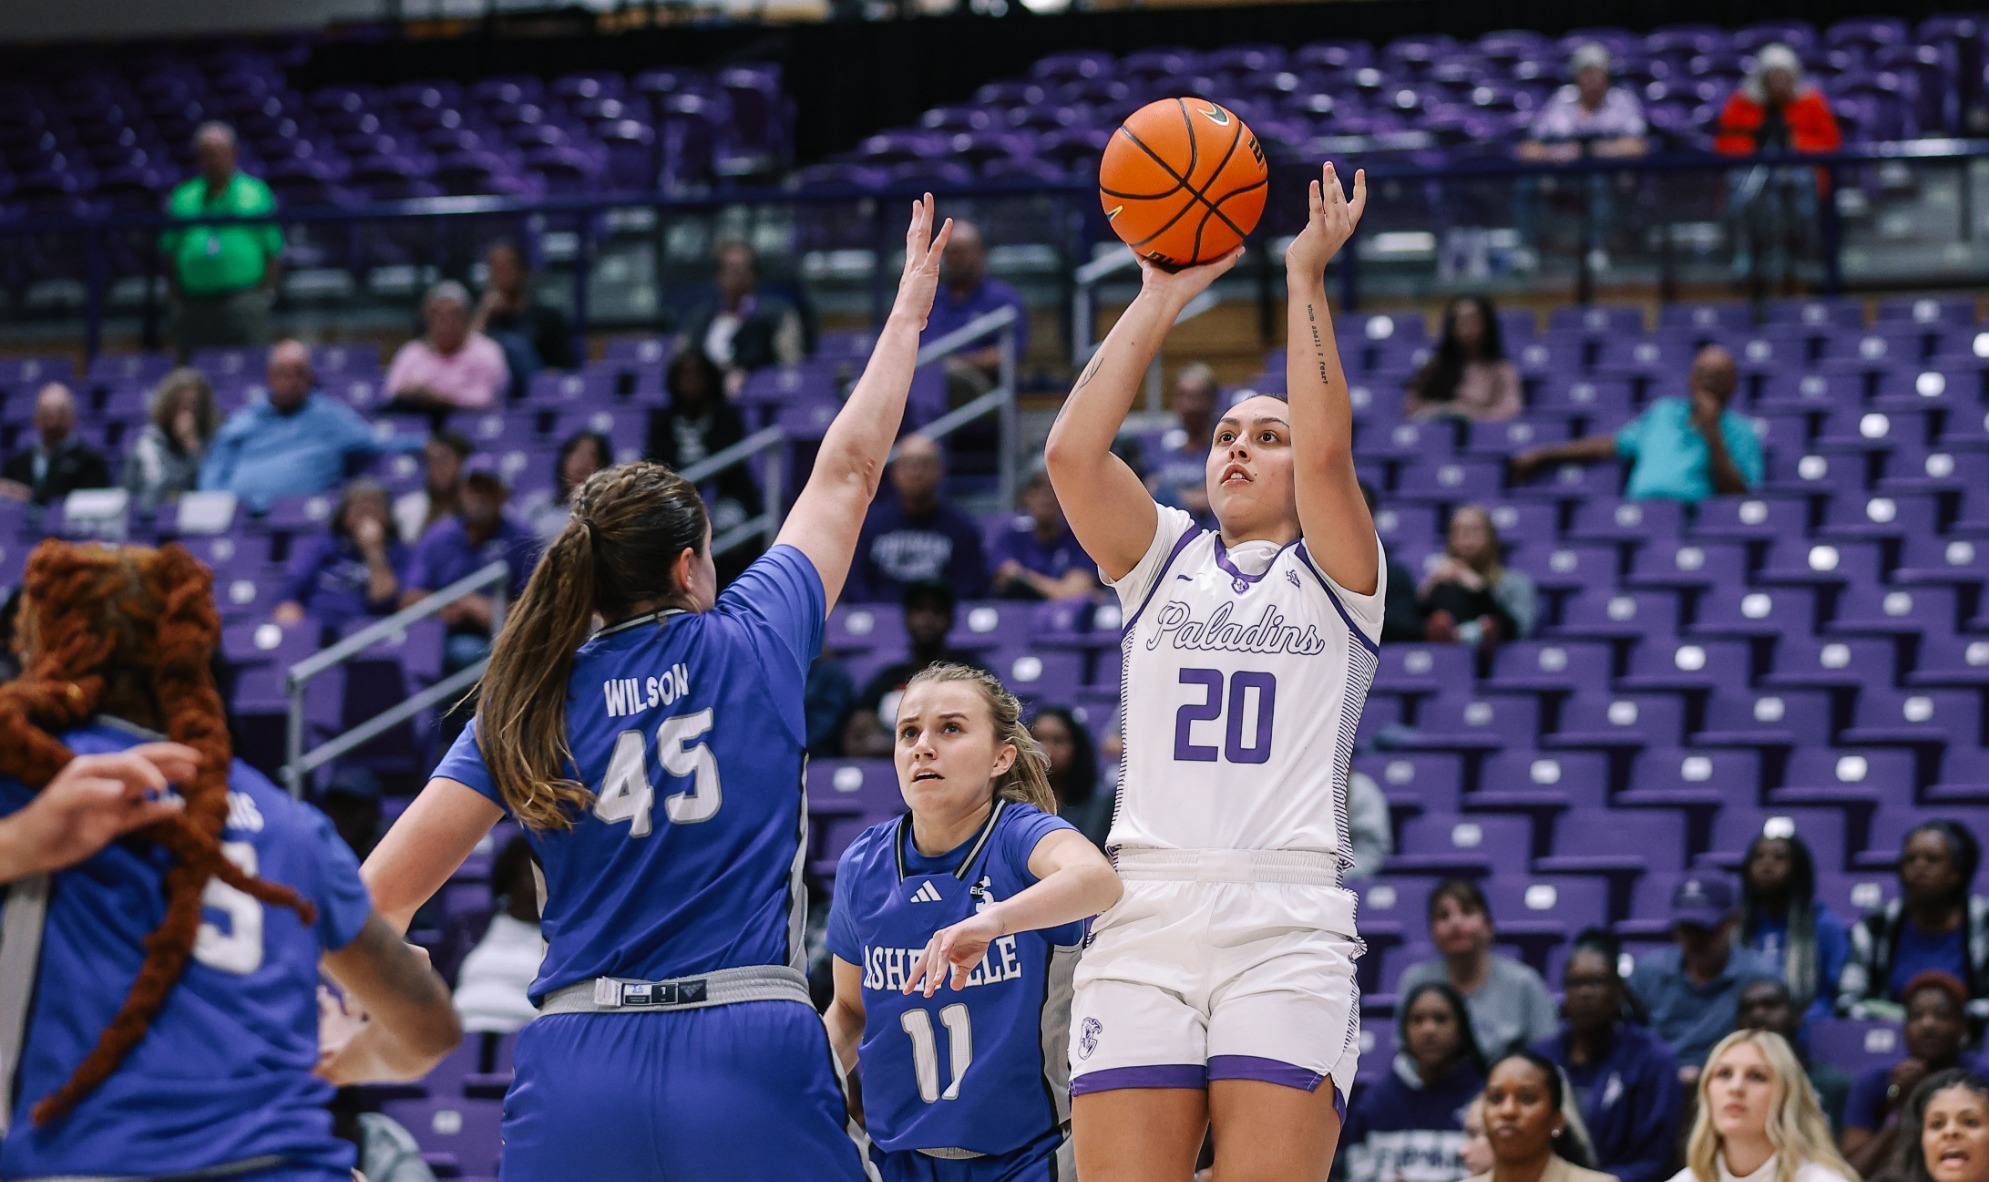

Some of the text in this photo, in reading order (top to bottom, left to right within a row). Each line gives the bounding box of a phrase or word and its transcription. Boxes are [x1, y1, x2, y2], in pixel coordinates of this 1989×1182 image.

[1146, 600, 1325, 655] Paladins
[603, 662, 690, 718] WILSON
[1173, 667, 1277, 765] 20
[592, 706, 723, 839] 45
[900, 1002, 973, 1104] 11
